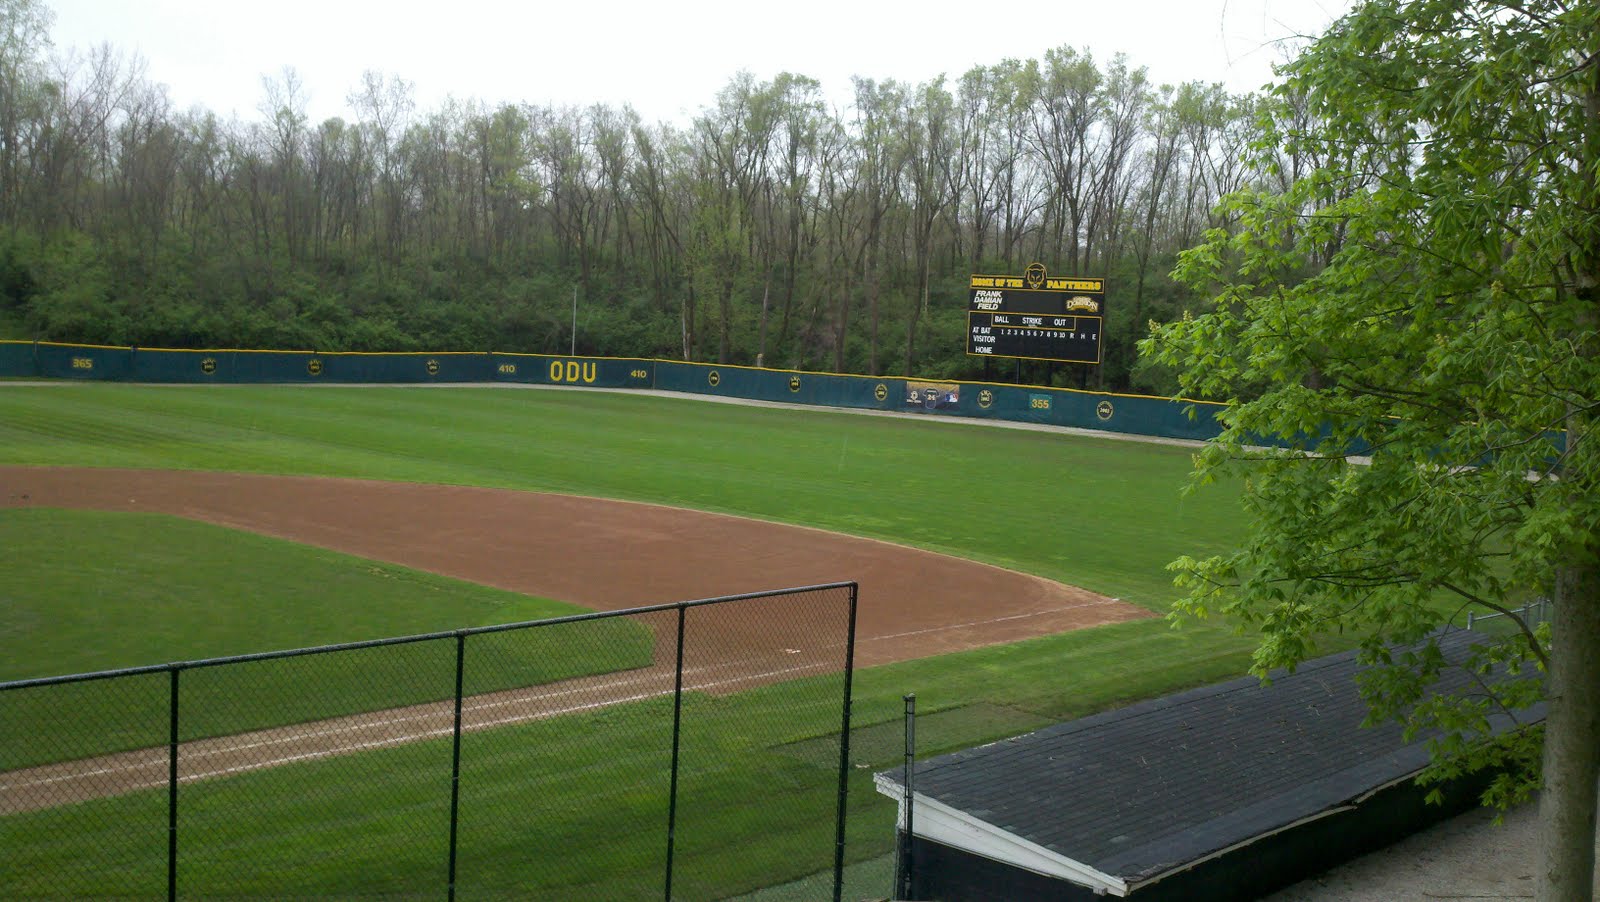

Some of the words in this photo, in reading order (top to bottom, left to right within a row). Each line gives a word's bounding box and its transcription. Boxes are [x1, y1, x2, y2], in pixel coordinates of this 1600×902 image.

[972, 278, 994, 287] HOME
[995, 279, 1006, 287] OF
[1006, 279, 1023, 287] THE
[1046, 280, 1101, 290] PANTHERS
[975, 290, 1002, 298] FRANK
[974, 296, 1002, 304] DAMIAN
[994, 316, 1009, 324] BALL
[1022, 317, 1042, 325] STRIKE
[1054, 318, 1066, 326] OUT
[972, 326, 980, 334] AT
[973, 335, 996, 343] VISITOR
[975, 346, 992, 354] HOME
[72, 358, 92, 368] 365
[499, 364, 515, 373] 410
[550, 361, 596, 382] ODU
[630, 369, 647, 378] 410
[1031, 398, 1049, 409] 355
